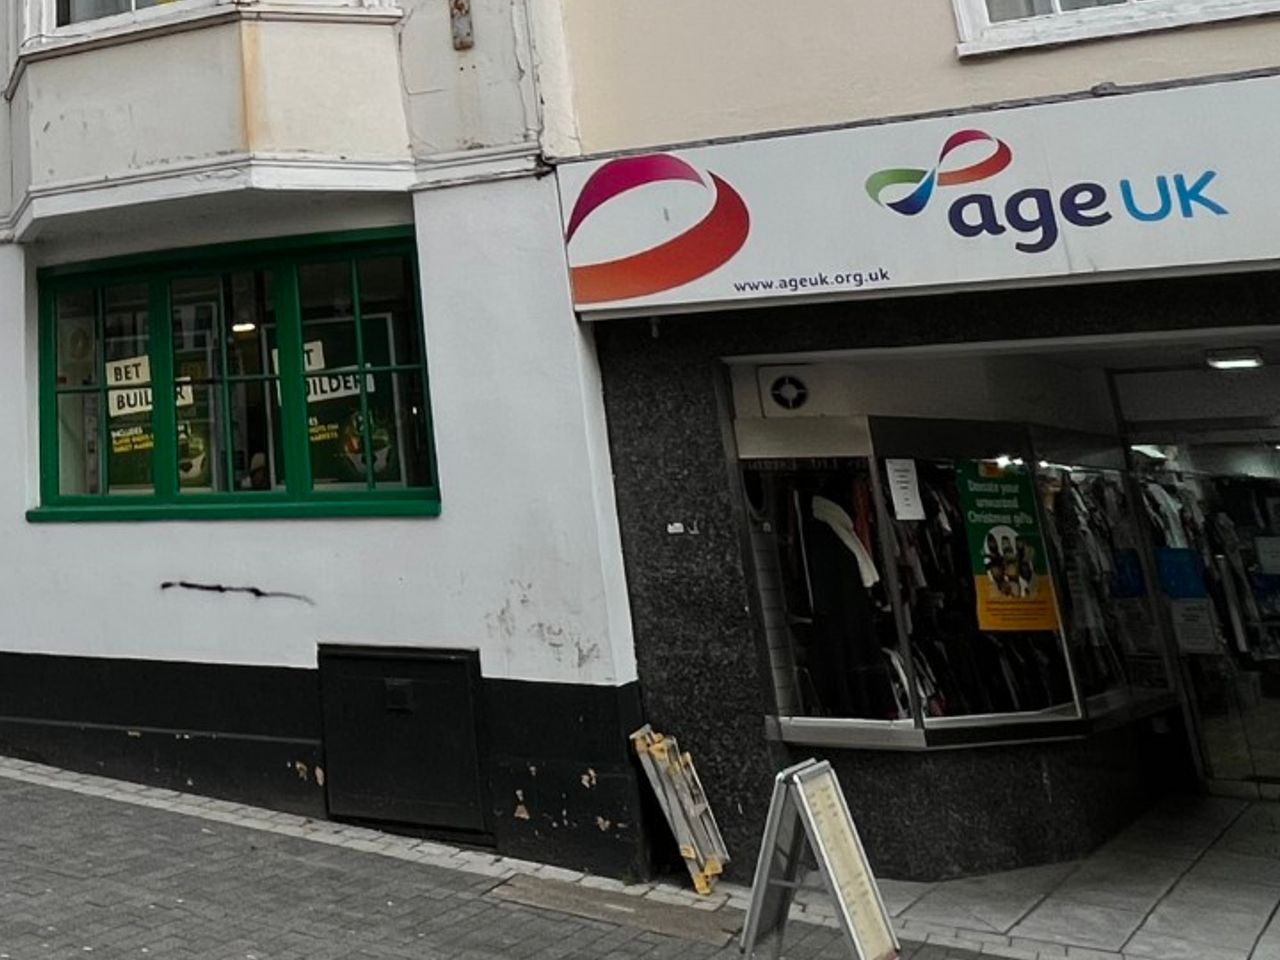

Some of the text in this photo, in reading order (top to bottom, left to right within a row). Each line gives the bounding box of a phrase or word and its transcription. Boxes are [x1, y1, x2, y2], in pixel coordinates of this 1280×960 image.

[948, 170, 1229, 253] age UK
[734, 267, 890, 291] www.ageuk.org.uk
[114, 363, 141, 381] BET
[116, 389, 185, 410] BUILR
[967, 480, 999, 493] Donate
[967, 509, 1034, 527] Christmas gifts
